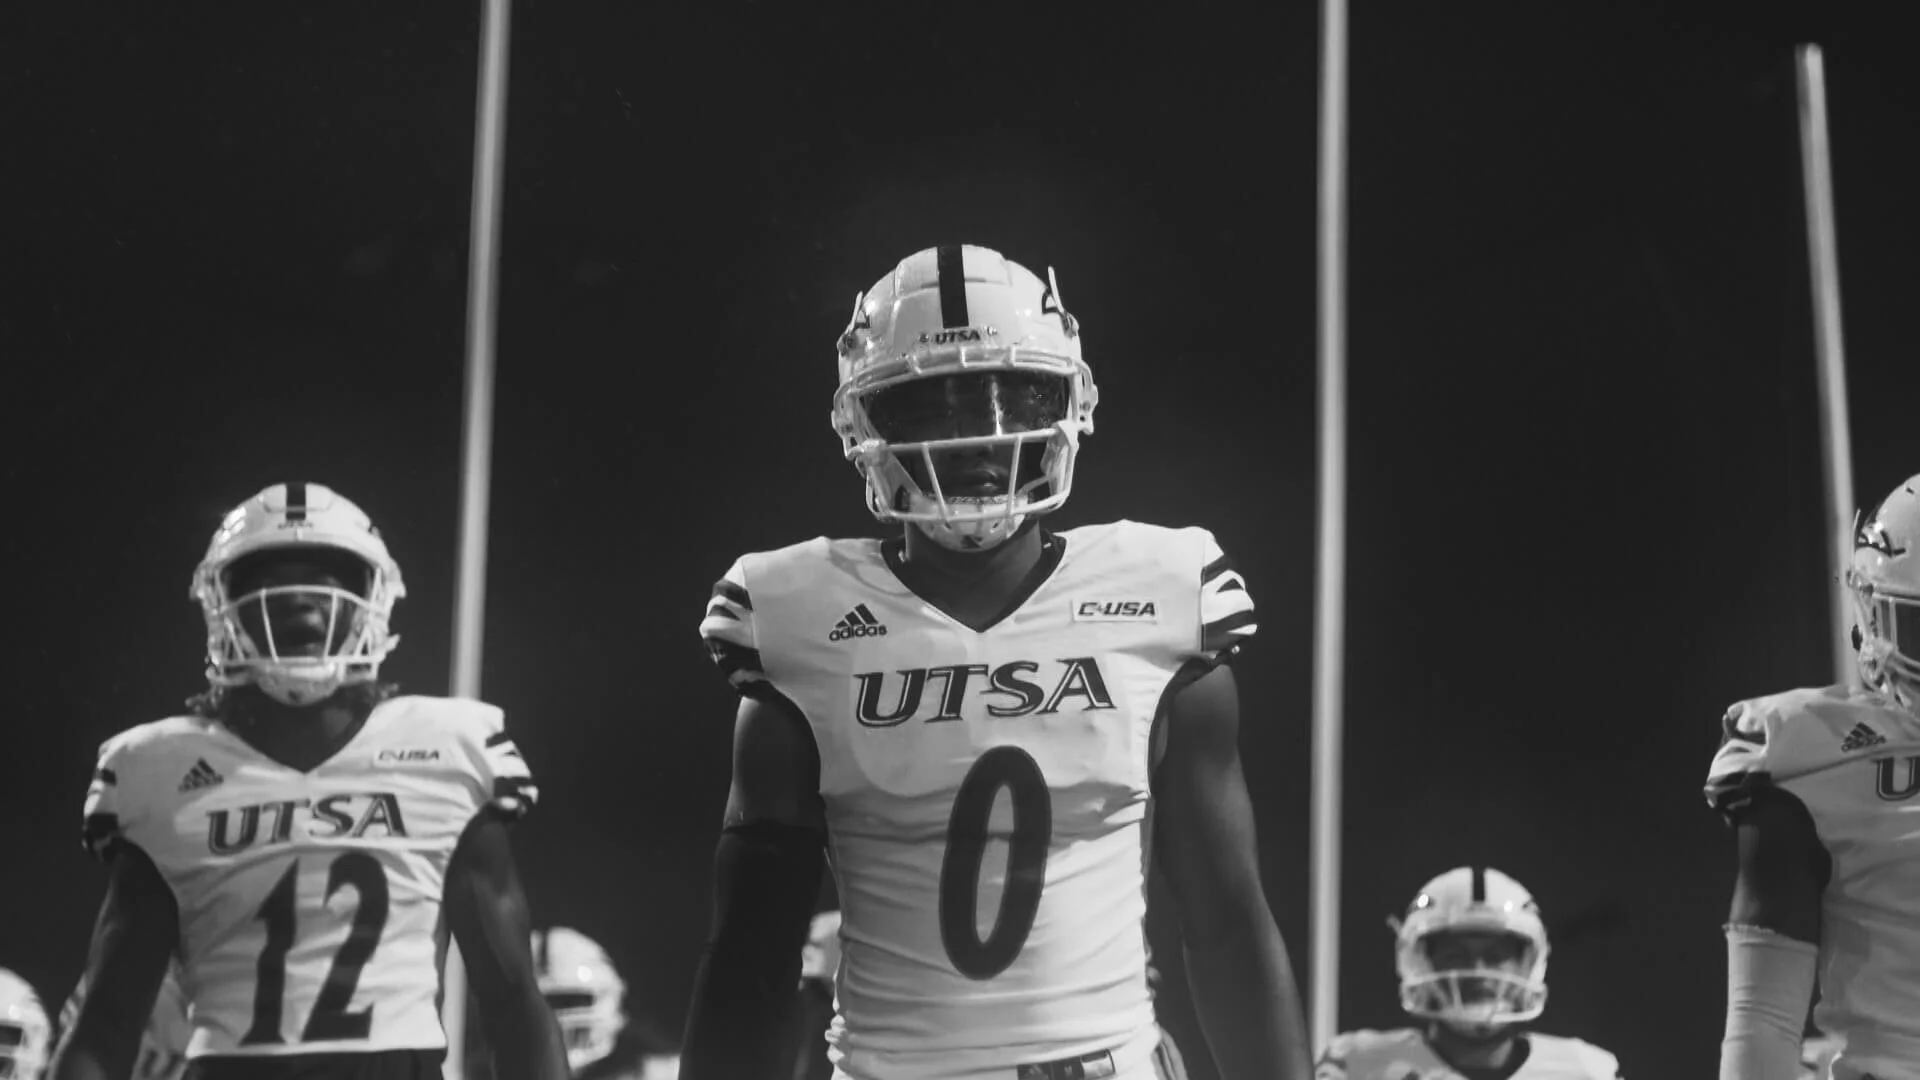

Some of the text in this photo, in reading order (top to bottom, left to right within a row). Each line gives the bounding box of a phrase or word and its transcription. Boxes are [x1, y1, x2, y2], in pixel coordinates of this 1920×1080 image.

[829, 625, 887, 641] adidas
[852, 656, 1117, 727] UTSA
[206, 792, 408, 857] UTSA
[939, 745, 1053, 981] 0
[237, 850, 390, 1047] 12
